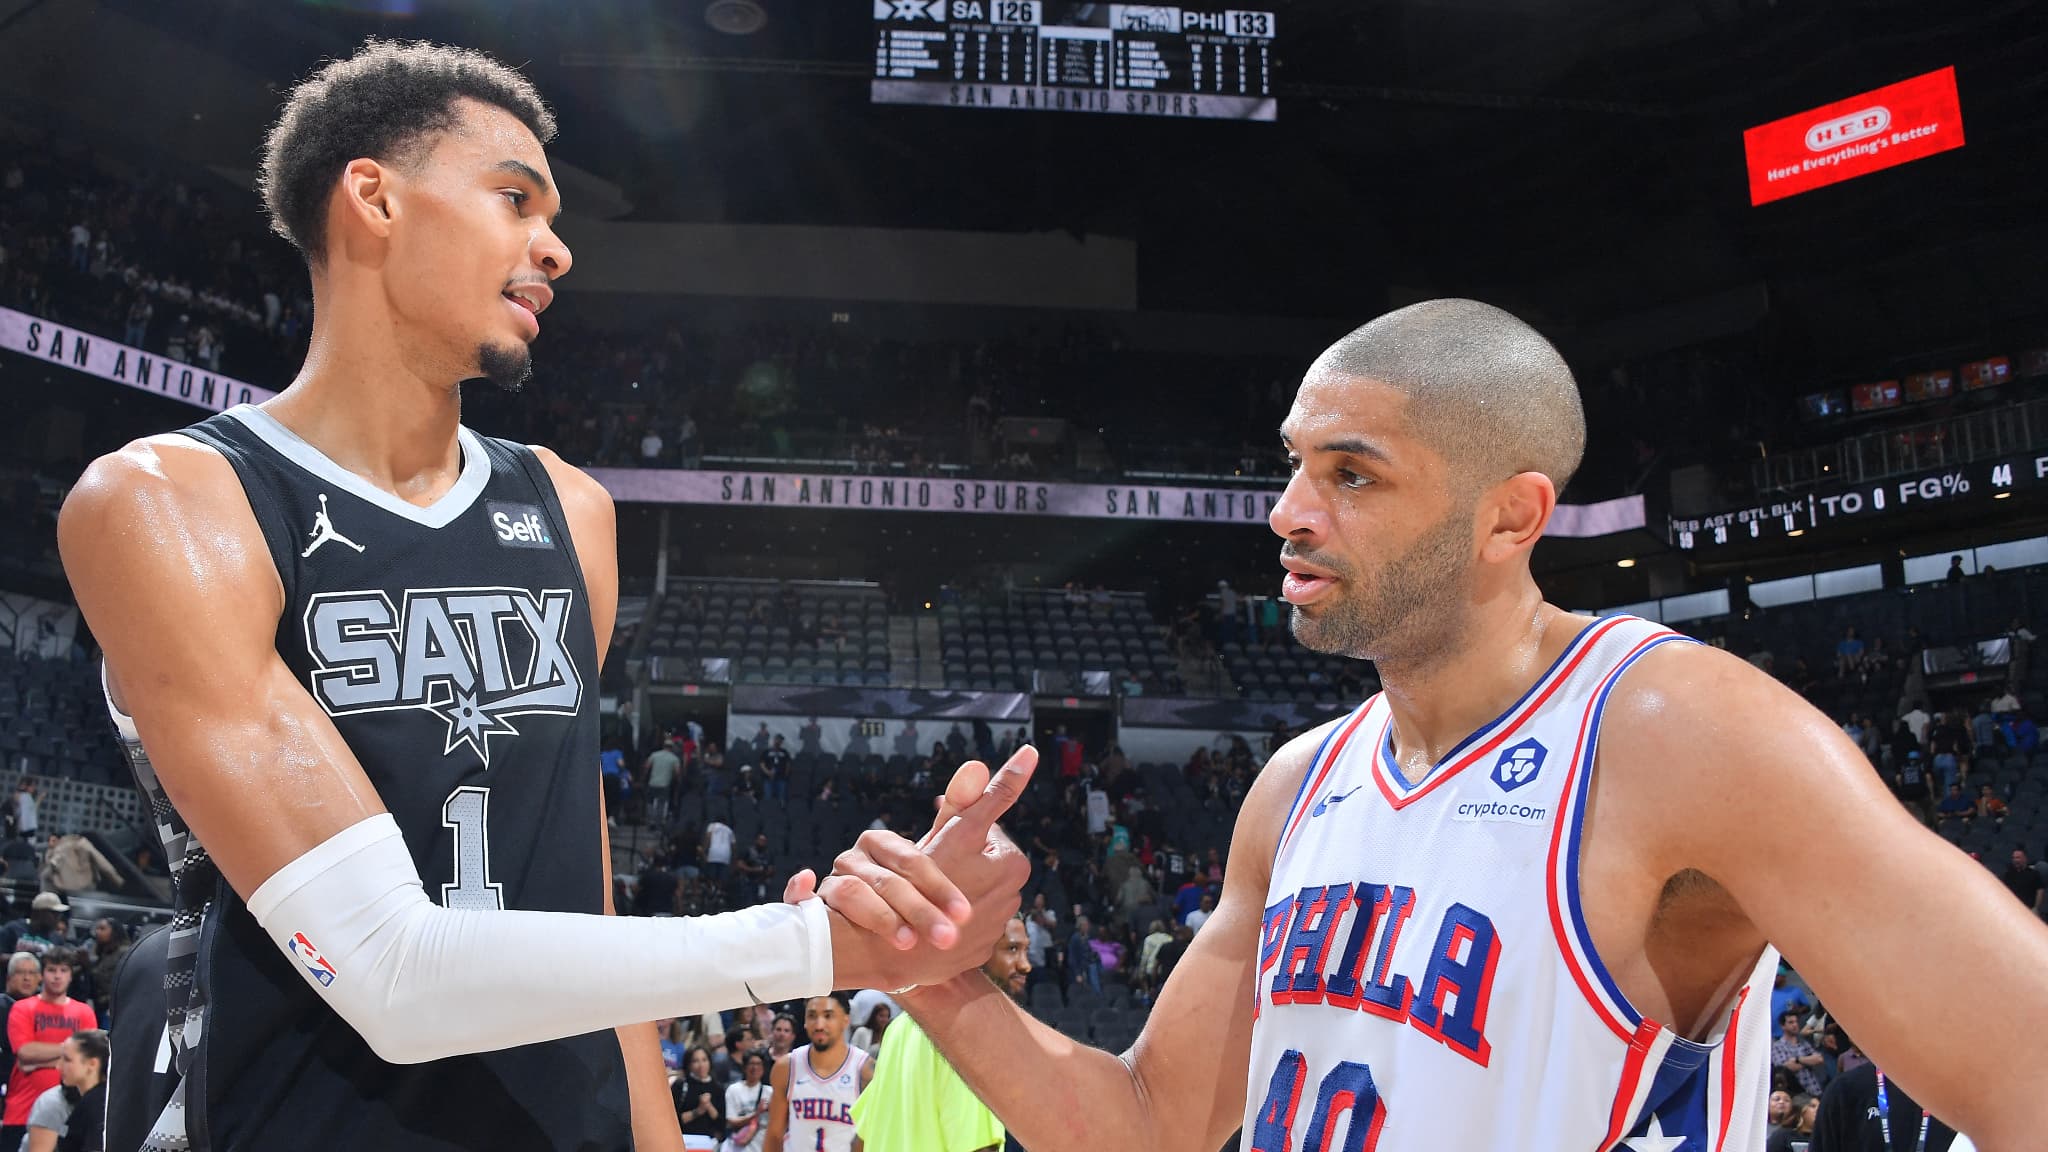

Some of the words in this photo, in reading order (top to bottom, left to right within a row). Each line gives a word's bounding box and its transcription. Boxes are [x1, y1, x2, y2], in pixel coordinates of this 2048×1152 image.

[952, 1, 983, 19] SA
[997, 2, 1033, 22] 126
[1182, 11, 1224, 30] PHI
[1233, 14, 1268, 34] 133
[951, 86, 991, 104] SAN
[1010, 88, 1109, 111] ANTONIO
[1126, 93, 1199, 114] SPURS
[1767, 163, 1800, 182] Here
[1802, 138, 1889, 172] Everything's
[1891, 122, 1939, 145] Better
[27, 322, 90, 367] SAN
[113, 349, 253, 410] ANTONIO
[721, 475, 776, 502] SAN
[799, 477, 930, 507] ANTONIO
[953, 483, 1048, 511] SPURS
[1106, 488, 1160, 515] SAN
[1820, 491, 1864, 519] TO
[1873, 486, 1886, 510] 0
[1899, 473, 1970, 503] FG%
[1991, 463, 2013, 488] 44
[1703, 512, 1735, 530] AST
[1738, 507, 1769, 523] STL
[1771, 499, 1804, 517] BLK
[303, 586, 584, 718] SATX
[860, 721, 884, 737] 111
[1457, 801, 1546, 821] crypto.com
[442, 786, 504, 911] 1
[1258, 882, 1503, 1069] PHILA
[1251, 1048, 1387, 1152] 40
[816, 1127, 826, 1152] 1
